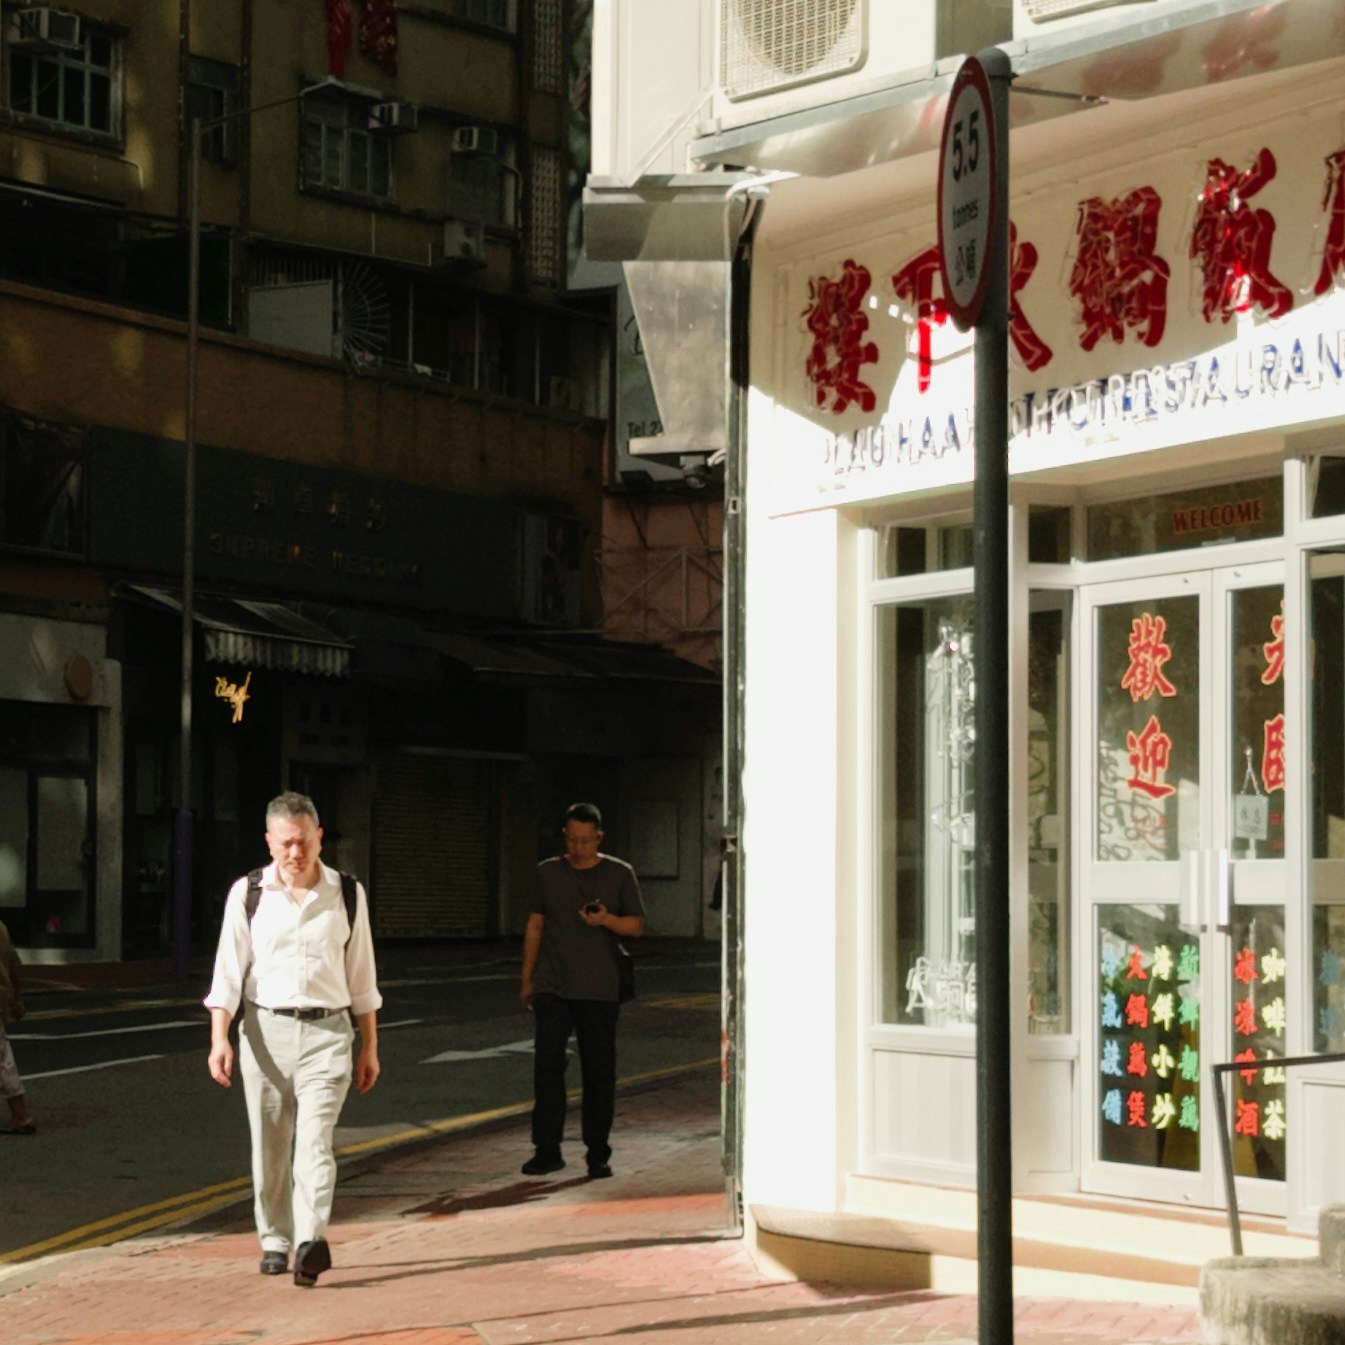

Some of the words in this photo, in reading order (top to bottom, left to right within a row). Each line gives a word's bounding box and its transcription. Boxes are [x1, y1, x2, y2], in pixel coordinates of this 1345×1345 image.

[953, 109, 979, 183] 5.5
[627, 421, 646, 437] Tel
[1172, 497, 1263, 533] WELCOME
[1121, 612, 1177, 799] 歡迎
